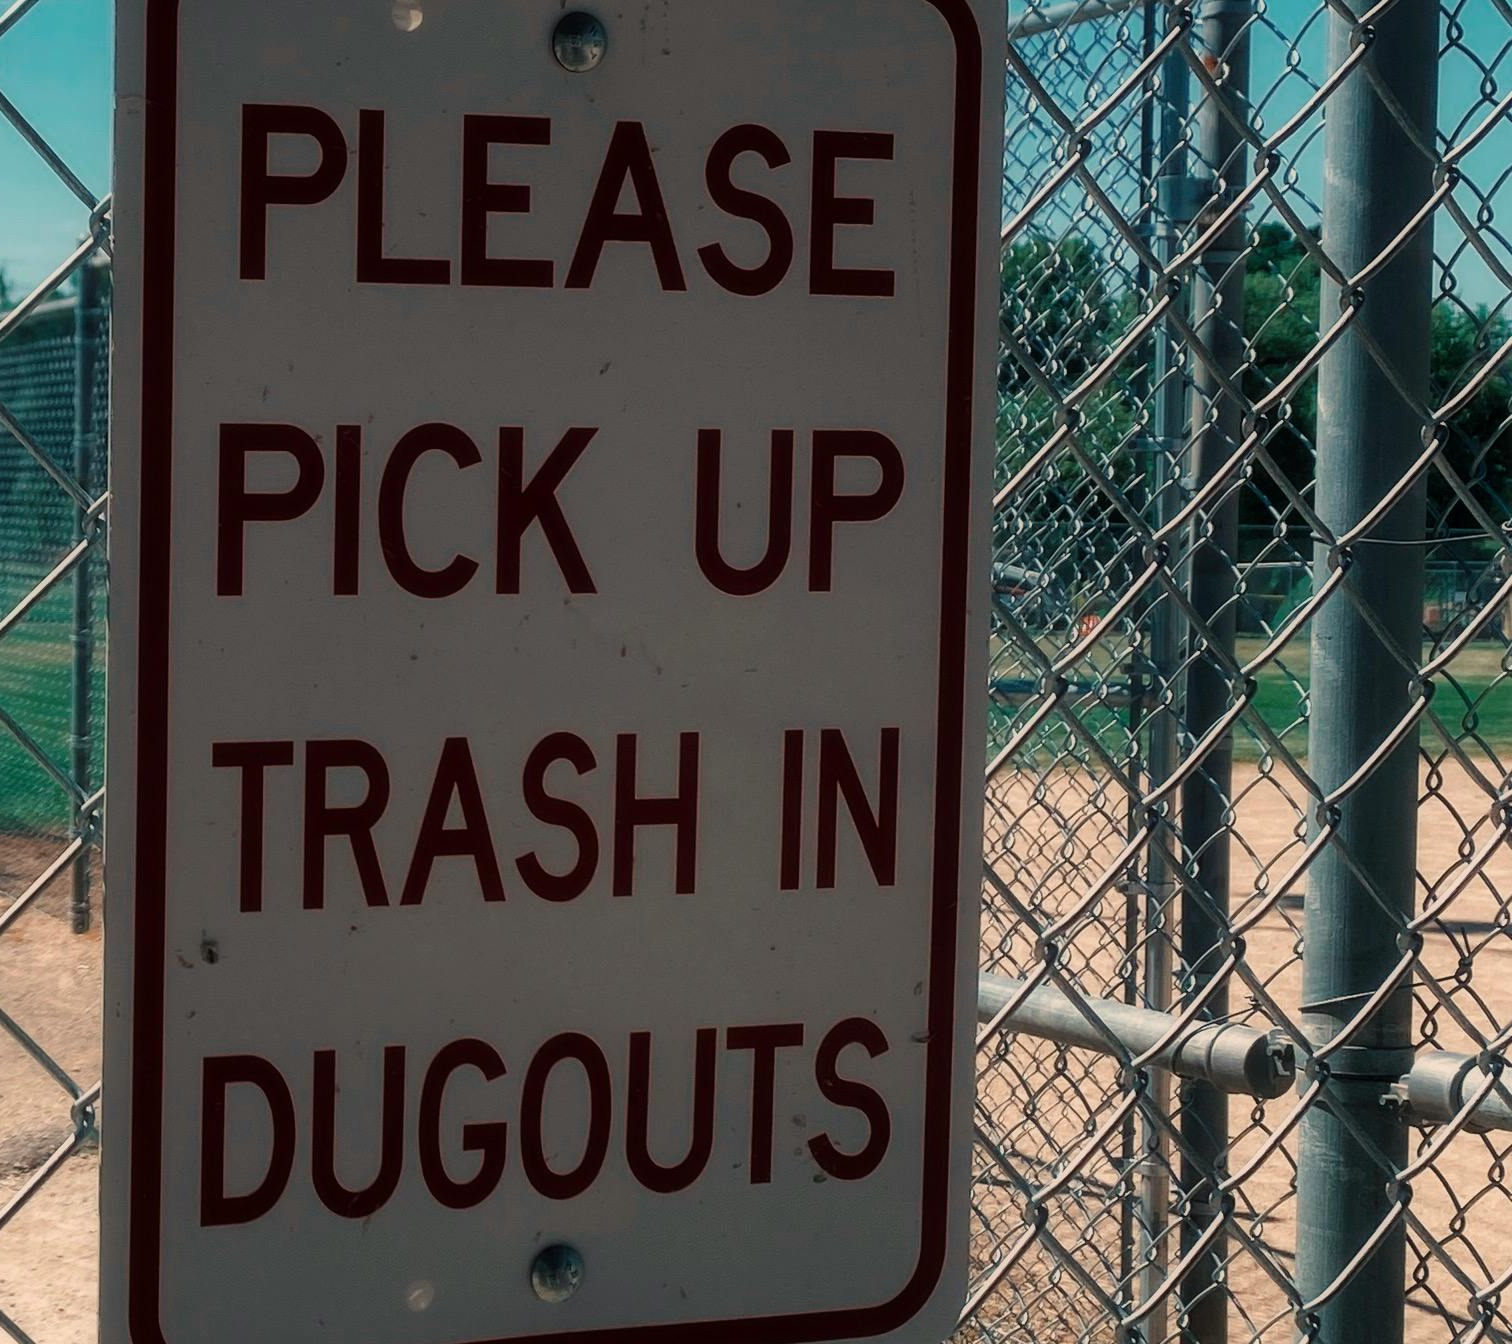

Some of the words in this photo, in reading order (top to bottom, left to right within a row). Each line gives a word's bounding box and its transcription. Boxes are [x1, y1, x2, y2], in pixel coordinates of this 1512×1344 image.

[237, 102, 897, 299] PLEASE
[214, 420, 601, 601] PICK
[690, 426, 907, 601] UP
[209, 726, 705, 915] TRASH
[779, 721, 901, 896] IN
[199, 1013, 893, 1228] DUGOUTS
